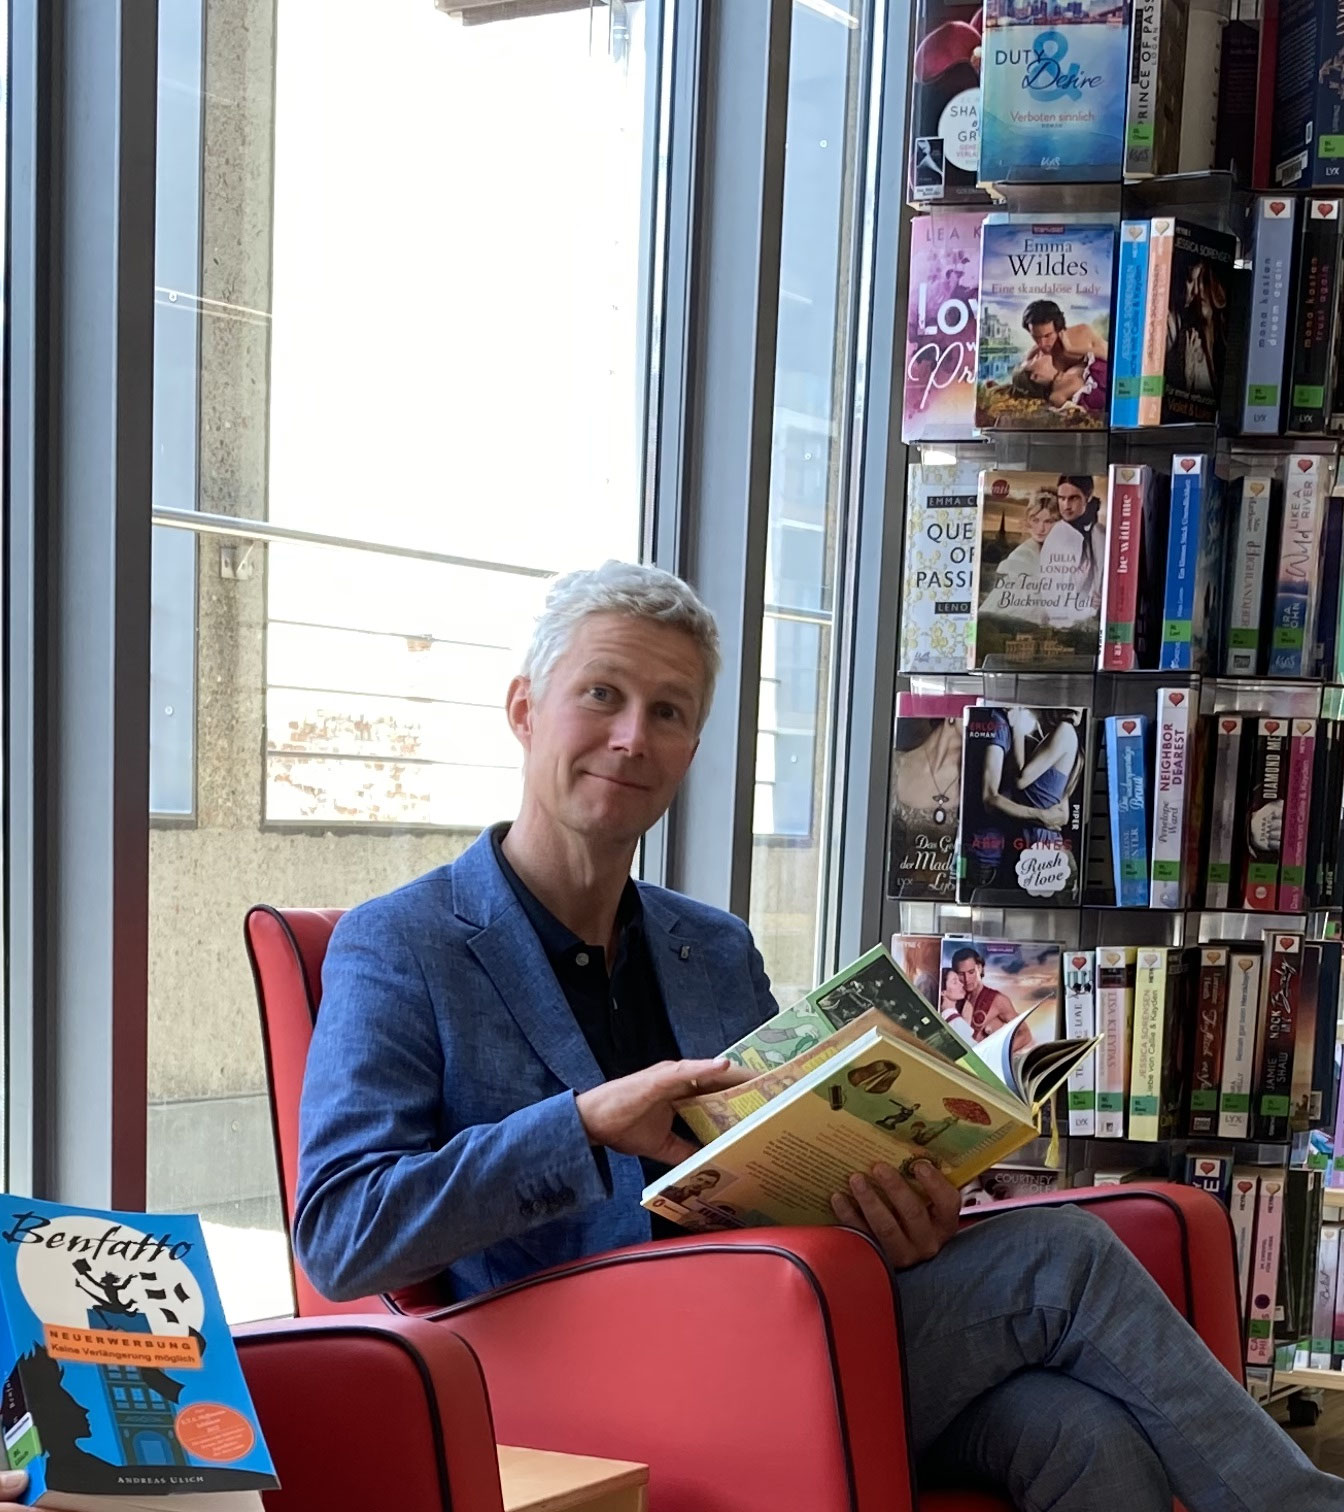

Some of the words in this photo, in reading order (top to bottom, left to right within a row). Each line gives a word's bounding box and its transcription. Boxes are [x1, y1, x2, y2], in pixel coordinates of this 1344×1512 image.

[994, 49, 1046, 66] DUTY
[1141, 40, 1152, 63] OF
[1021, 57, 1105, 90] Desire
[1010, 111, 1057, 123] Verboten
[1058, 111, 1096, 123] sinnlich
[1325, 167, 1341, 177] LYX
[925, 226, 961, 242] LEA
[1023, 239, 1073, 254] Emma
[1008, 253, 1089, 278] Wildes
[991, 284, 1015, 296] Eine
[1017, 283, 1072, 295] skandalöse
[1075, 283, 1102, 297] Lady
[1259, 257, 1272, 305] kasten
[1272, 261, 1284, 299] again
[1305, 256, 1318, 305] kasten
[1258, 310, 1268, 349] mona
[1267, 303, 1281, 347] dream
[1304, 311, 1314, 349] mona
[1298, 414, 1313, 423] LYX
[1121, 493, 1133, 518] me
[1301, 481, 1314, 520] RIVER
[1289, 502, 1301, 530] LIKE
[926, 522, 974, 544] QUE
[1119, 518, 1131, 554] with
[1039, 564, 1085, 575] LONDON
[1048, 553, 1077, 565] JULIA
[1117, 556, 1129, 575] be
[994, 574, 1016, 591] Der
[1018, 572, 1053, 596] Teufel
[1055, 582, 1075, 592] von
[997, 590, 1060, 609] Blackwood
[969, 731, 997, 739] ROMAN
[1159, 722, 1174, 793] NEIGHBOR
[1172, 729, 1186, 786] DEAREST
[1262, 754, 1282, 799] DIAMOND
[1071, 803, 1080, 831] PIPER
[1157, 801, 1171, 844] Penelope
[899, 856, 915, 871] der
[1019, 852, 1063, 875] Rush
[1034, 871, 1065, 888] love
[1140, 989, 1151, 1040] SORENSEN
[1150, 989, 1160, 1021] Kayden
[1147, 1031, 1158, 1055] Callie
[1139, 1041, 1149, 1079] JESSICA
[1148, 1056, 1156, 1073] von
[1266, 1058, 1278, 1090] JAMIE
[1075, 1117, 1089, 1127] LYX
[1224, 1114, 1244, 1124] LYX
[994, 1173, 1055, 1185] COURTNEY
[1, 1210, 196, 1263] Benfatto
[49, 1329, 192, 1351] NEUERWERBUNG
[51, 1343, 82, 1356] Keine
[83, 1347, 153, 1363] Verlängerung
[154, 1352, 196, 1365] möglich
[117, 1476, 167, 1485] ANDREAS
